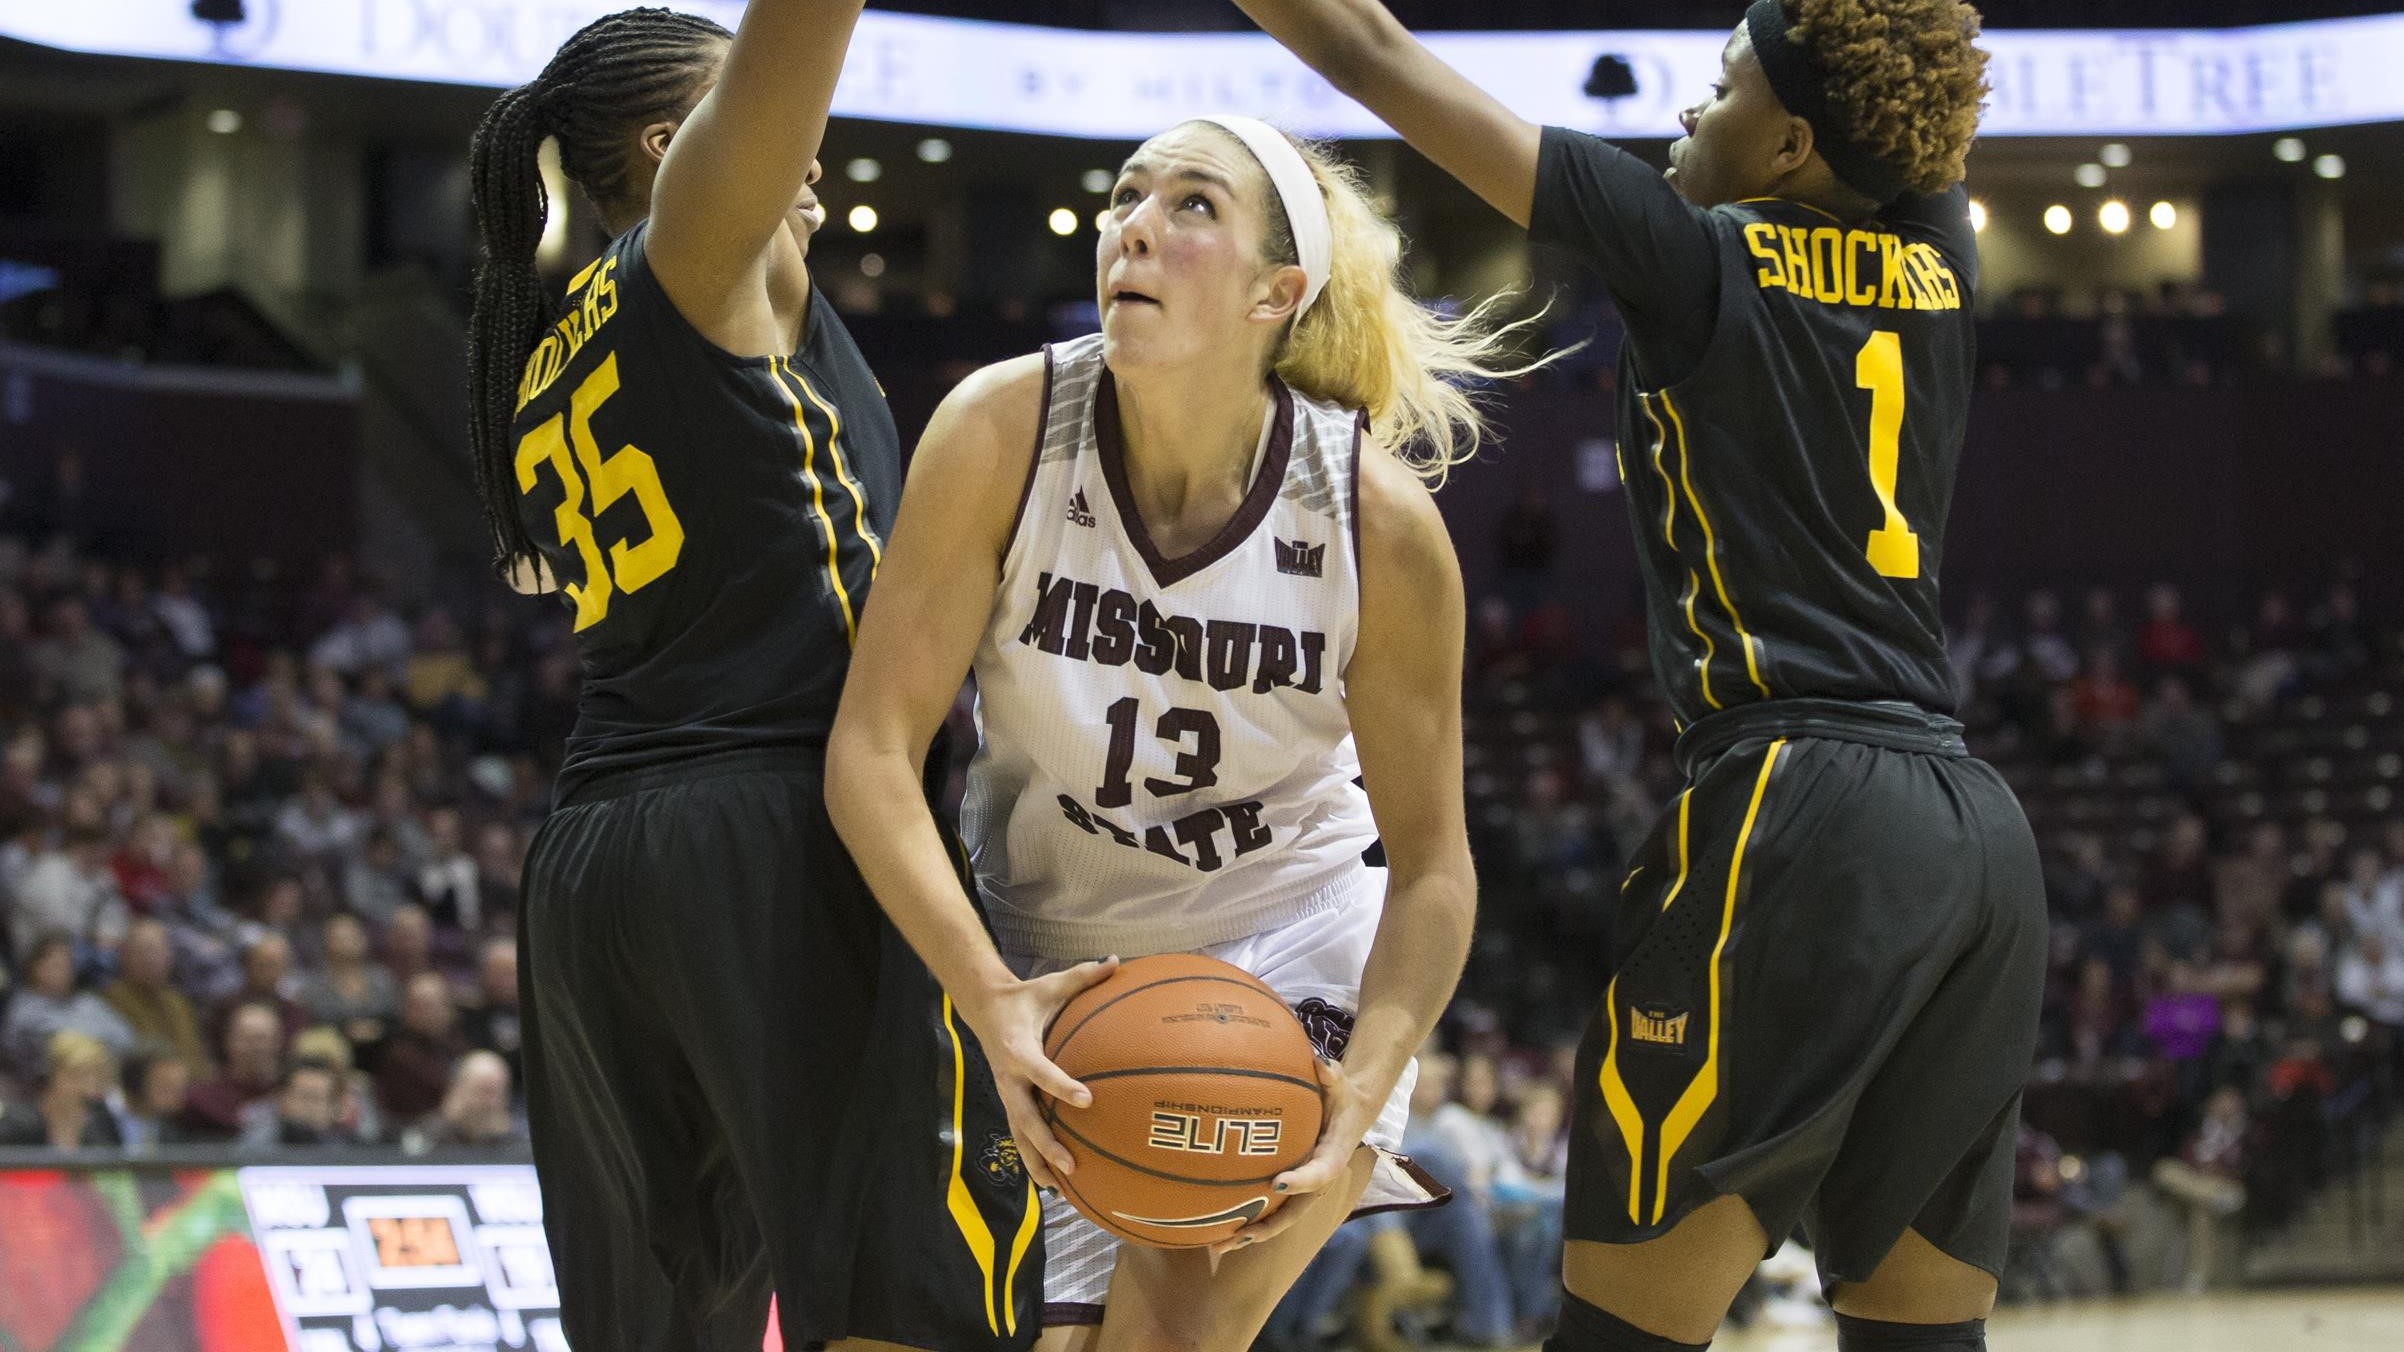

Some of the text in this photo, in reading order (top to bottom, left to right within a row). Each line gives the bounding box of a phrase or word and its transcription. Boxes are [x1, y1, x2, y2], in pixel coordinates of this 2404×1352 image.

[514, 350, 686, 634] 35
[1856, 330, 1919, 579] 1
[1018, 571, 1327, 695] MISSOURI
[1095, 696, 1222, 809] 13
[1148, 1111, 1282, 1156] ELITE
[1153, 1099, 1283, 1117] CHAMPIONSHIP
